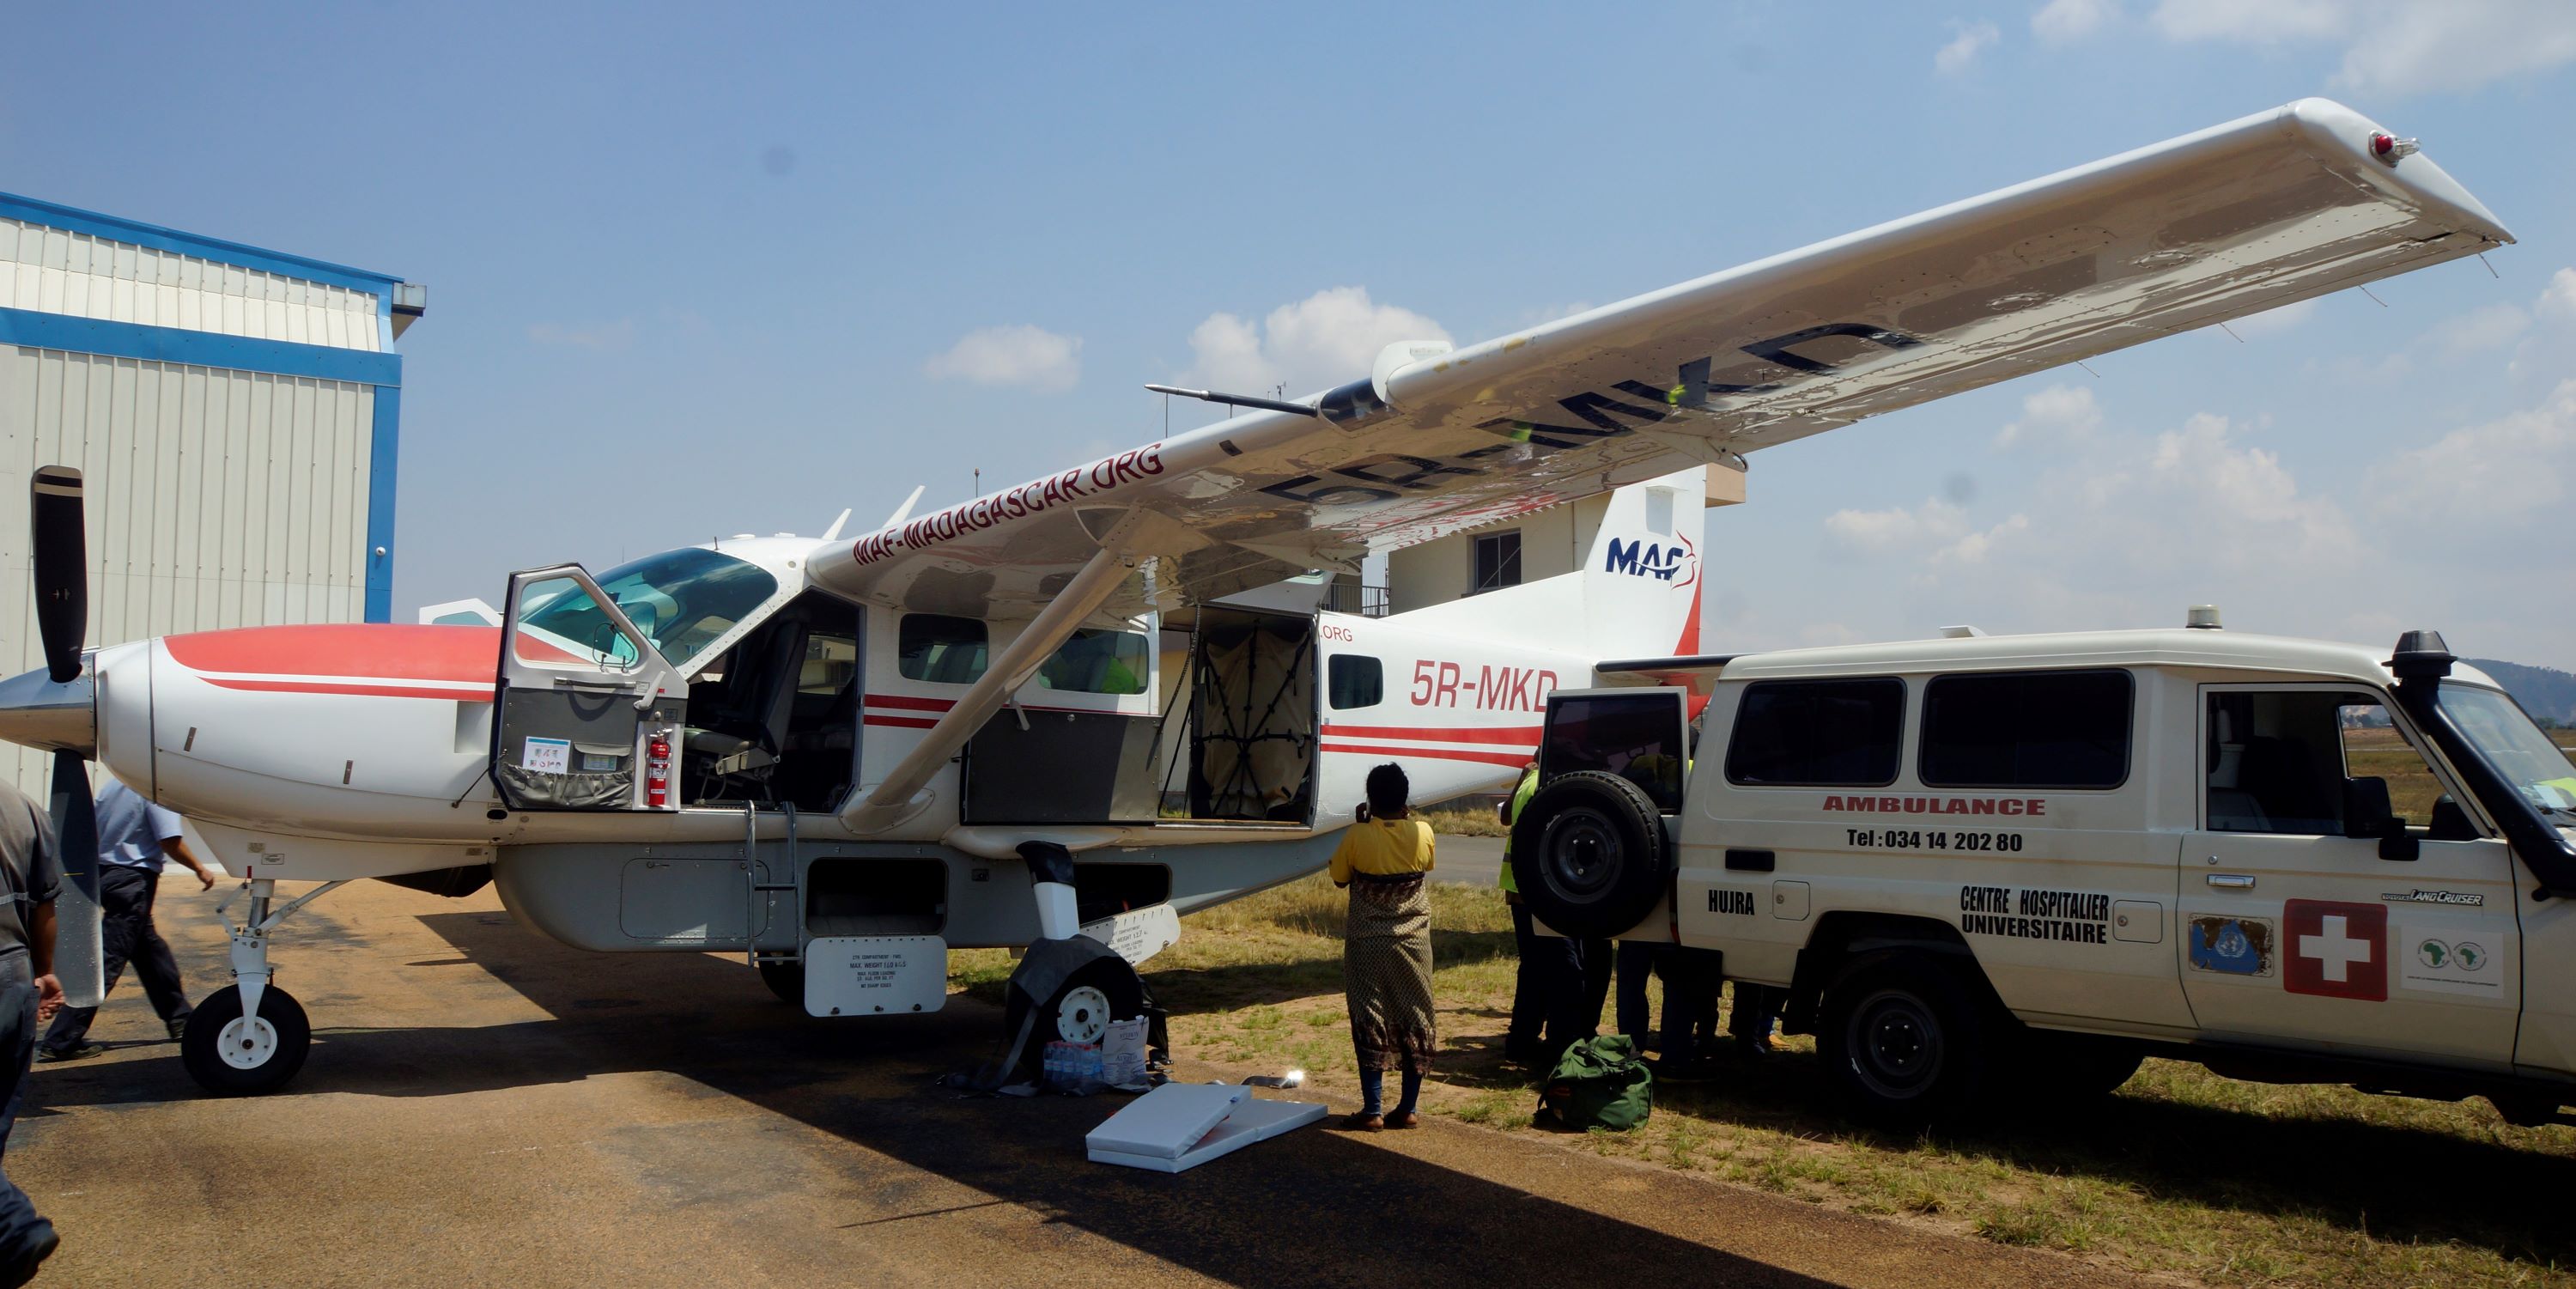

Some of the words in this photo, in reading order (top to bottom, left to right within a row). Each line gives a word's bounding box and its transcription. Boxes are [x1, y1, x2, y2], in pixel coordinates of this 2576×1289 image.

[853, 442, 1164, 566] MAF-MADAGASCAR.ORG
[1410, 660, 1558, 713] 5R-MKD
[1822, 796, 2046, 816] AMBULANCE
[1926, 832, 1947, 849] 14
[1954, 833, 1992, 851] 202
[1996, 834, 2023, 852] 80
[1708, 890, 1755, 915] HUJRA
[1960, 885, 2010, 914] CENTRE
[2020, 889, 2110, 921] HOSPITALIER
[1962, 914, 2107, 944] UNIVERSITAIRE
